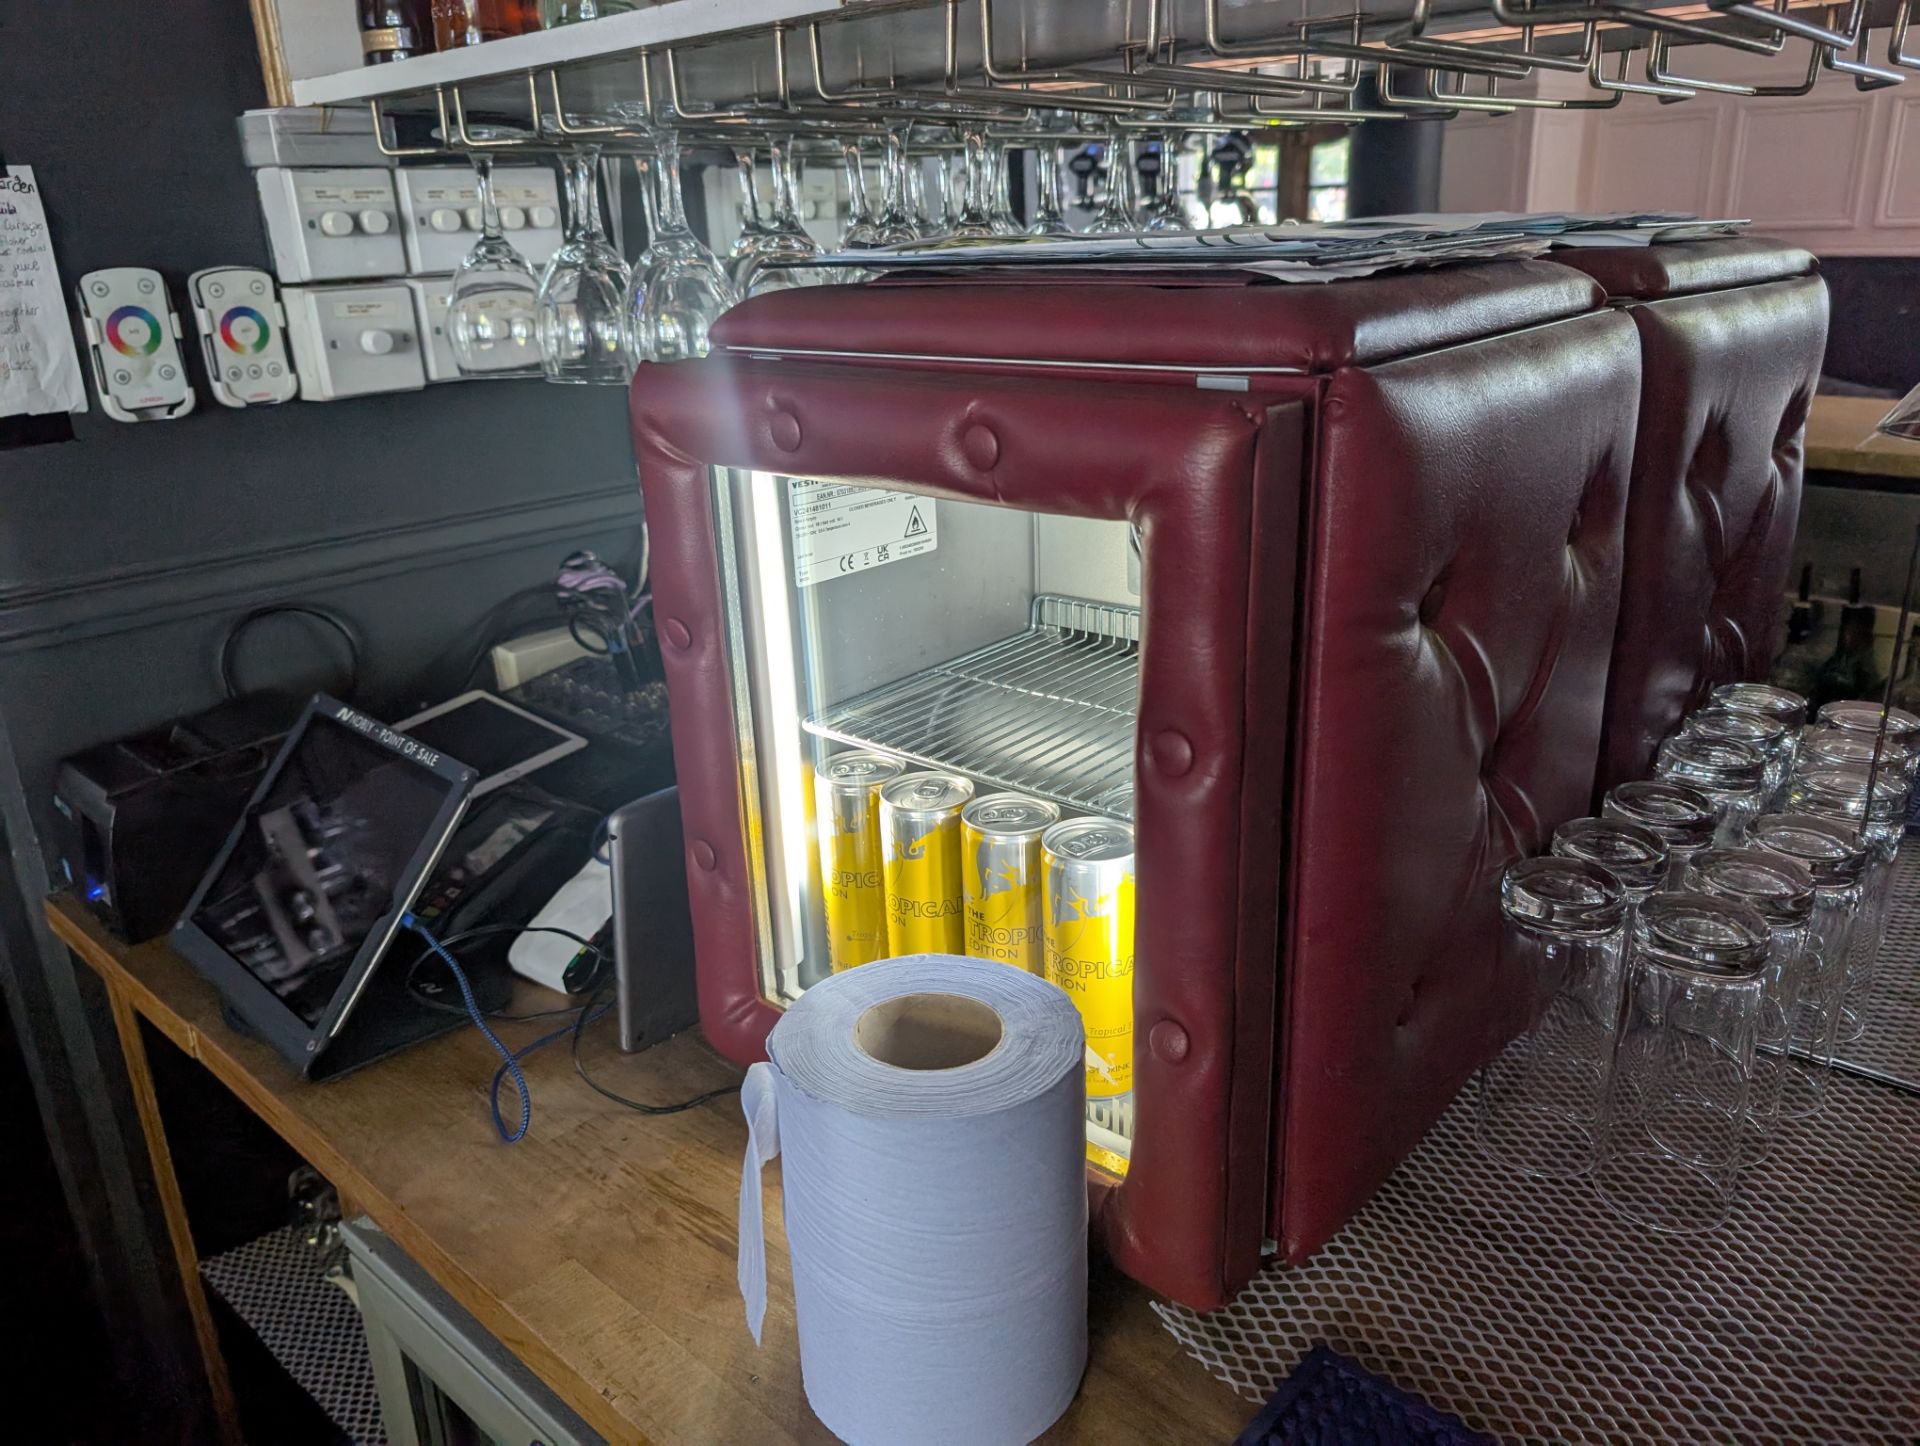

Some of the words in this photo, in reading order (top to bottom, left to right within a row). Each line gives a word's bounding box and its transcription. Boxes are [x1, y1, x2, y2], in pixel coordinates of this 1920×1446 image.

[791, 480, 819, 489] VEST
[379, 728, 406, 750] POINT
[403, 741, 419, 755] OF
[415, 747, 441, 767] SALE
[967, 906, 985, 922] THE
[968, 938, 1019, 960] EDITION
[1086, 1096, 1132, 1140] ull
